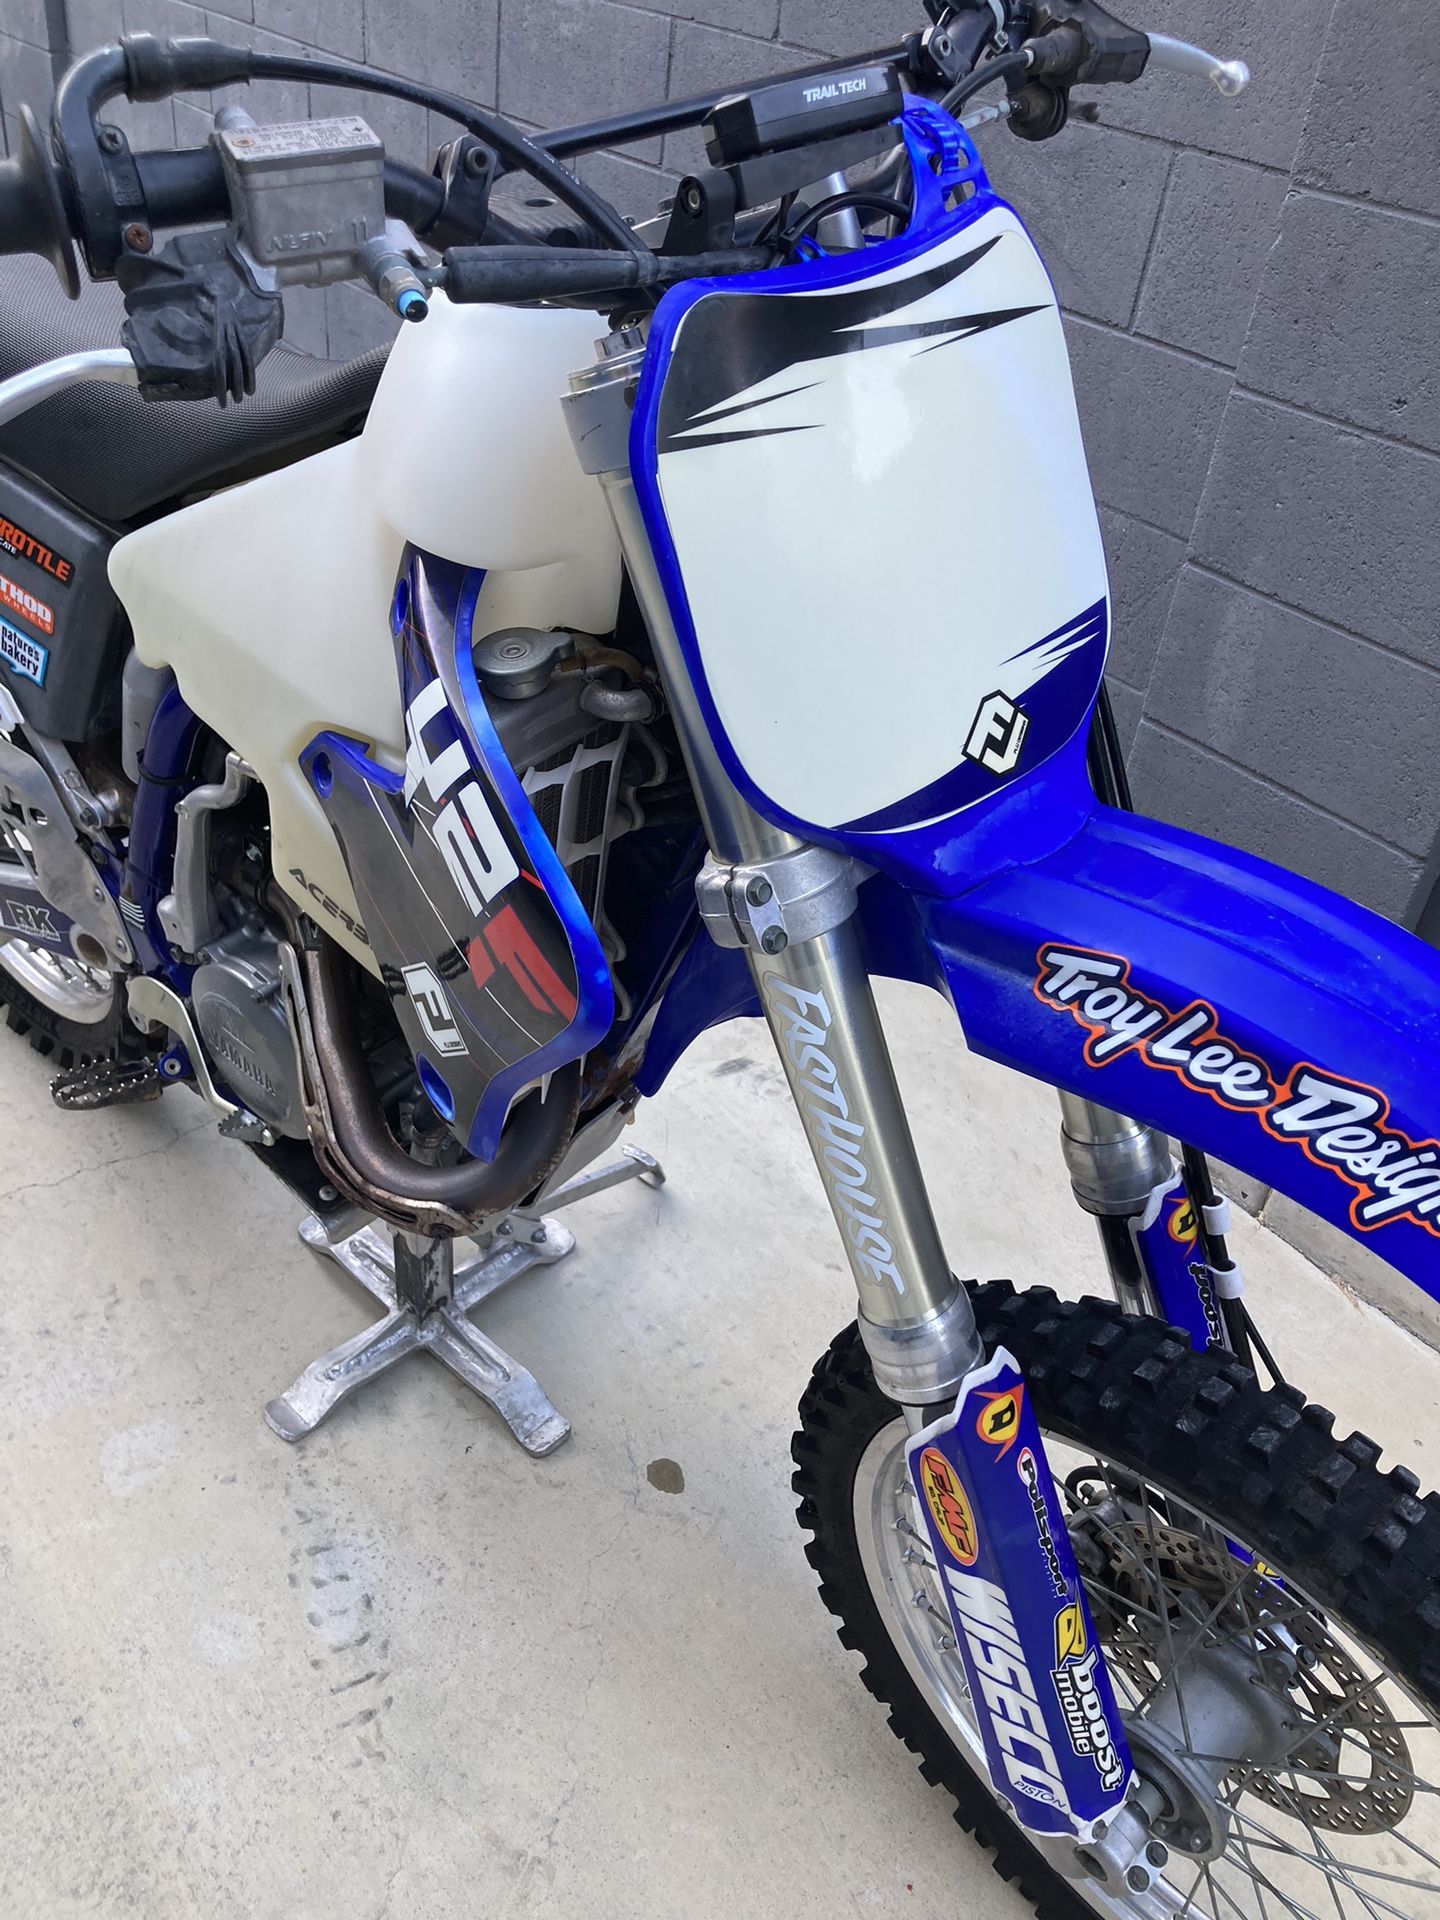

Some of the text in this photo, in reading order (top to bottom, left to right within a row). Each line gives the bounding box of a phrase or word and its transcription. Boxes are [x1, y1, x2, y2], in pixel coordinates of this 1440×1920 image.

[803, 78, 867, 102] TRAIL TECH
[0, 519, 70, 581] ROTTLE
[1, 637, 39, 676] bakery
[2, 625, 40, 662] nature's
[8, 900, 60, 935] RK
[289, 868, 371, 947] ACERB
[1045, 952, 1163, 1057] Troy
[1151, 1011, 1268, 1101] Lee
[768, 976, 905, 1296] FASTHOUSE
[924, 1454, 973, 1557] FMF
[945, 1566, 1070, 1814] WISECO
[1055, 1673, 1091, 1755] mobile
[1071, 1650, 1124, 1790] boost
[1014, 1780, 1067, 1809] PISTON
